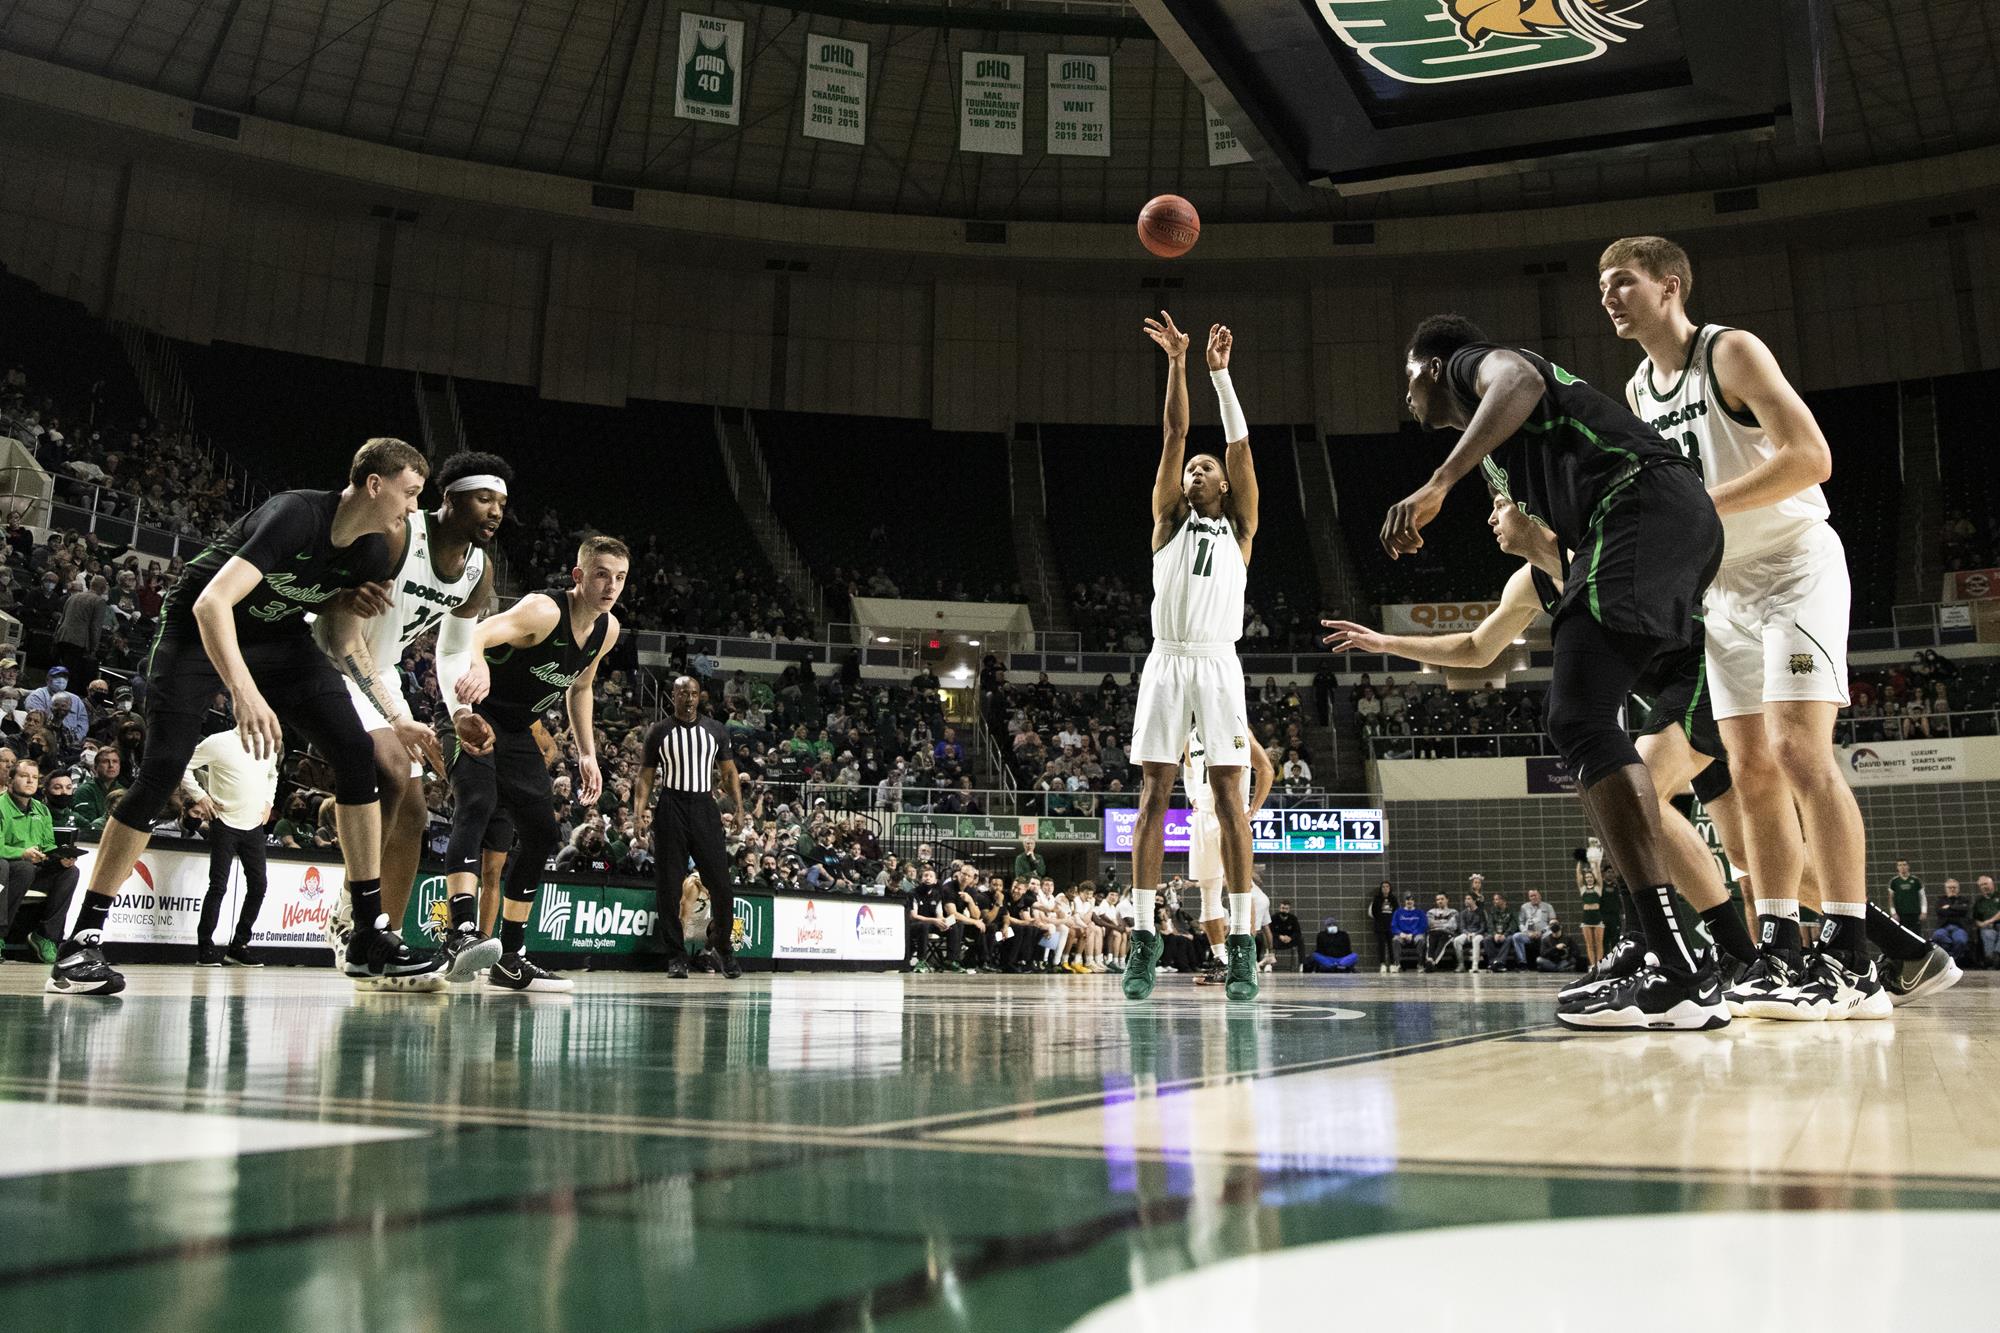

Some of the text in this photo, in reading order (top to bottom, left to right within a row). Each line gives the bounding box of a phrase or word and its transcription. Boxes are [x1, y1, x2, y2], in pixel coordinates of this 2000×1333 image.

[699, 19, 727, 32] MAST
[821, 45, 854, 68] OHIO
[695, 55, 725, 75] OHIO
[809, 63, 865, 78] WOMEN'S BASKETBALL
[976, 60, 1010, 81] OHIO
[1062, 61, 1096, 82] OHIO
[698, 74, 720, 92] 40
[827, 83, 846, 94] MAC
[965, 79, 1022, 90] WOMEN'S BASKETBALL
[1076, 83, 1108, 91] BASKETBALL
[812, 90, 860, 105] CHAMPIONS
[983, 91, 1002, 100] MAC
[965, 98, 1020, 110] TOURNAMENT
[1063, 100, 1095, 112] WNIT
[838, 107, 859, 119] 1995
[968, 107, 1017, 118] CHAMPIONS
[811, 113, 859, 129] 2015 2016
[969, 118, 1017, 130] 1986 2015
[1055, 121, 1103, 132] 2016 2017
[1215, 139, 1237, 150] 2015
[1647, 400, 1707, 432] OBCATS
[402, 580, 463, 608] BOBCAT
[1410, 604, 1500, 628] QDO
[1883, 759, 1906, 767] WHITE
[1289, 813, 1339, 830] 10:44
[1116, 825, 1131, 833] we
[1253, 821, 1276, 839] 14
[1352, 822, 1375, 839] 12
[113, 894, 201, 912] DAVID WHITE
[112, 913, 175, 926] SERVICES, INC.
[574, 900, 659, 936] Holzer
[252, 931, 327, 942] ree Convenient Athen
[861, 926, 893, 936] DAVID WHITE
[572, 938, 616, 949] Health System
